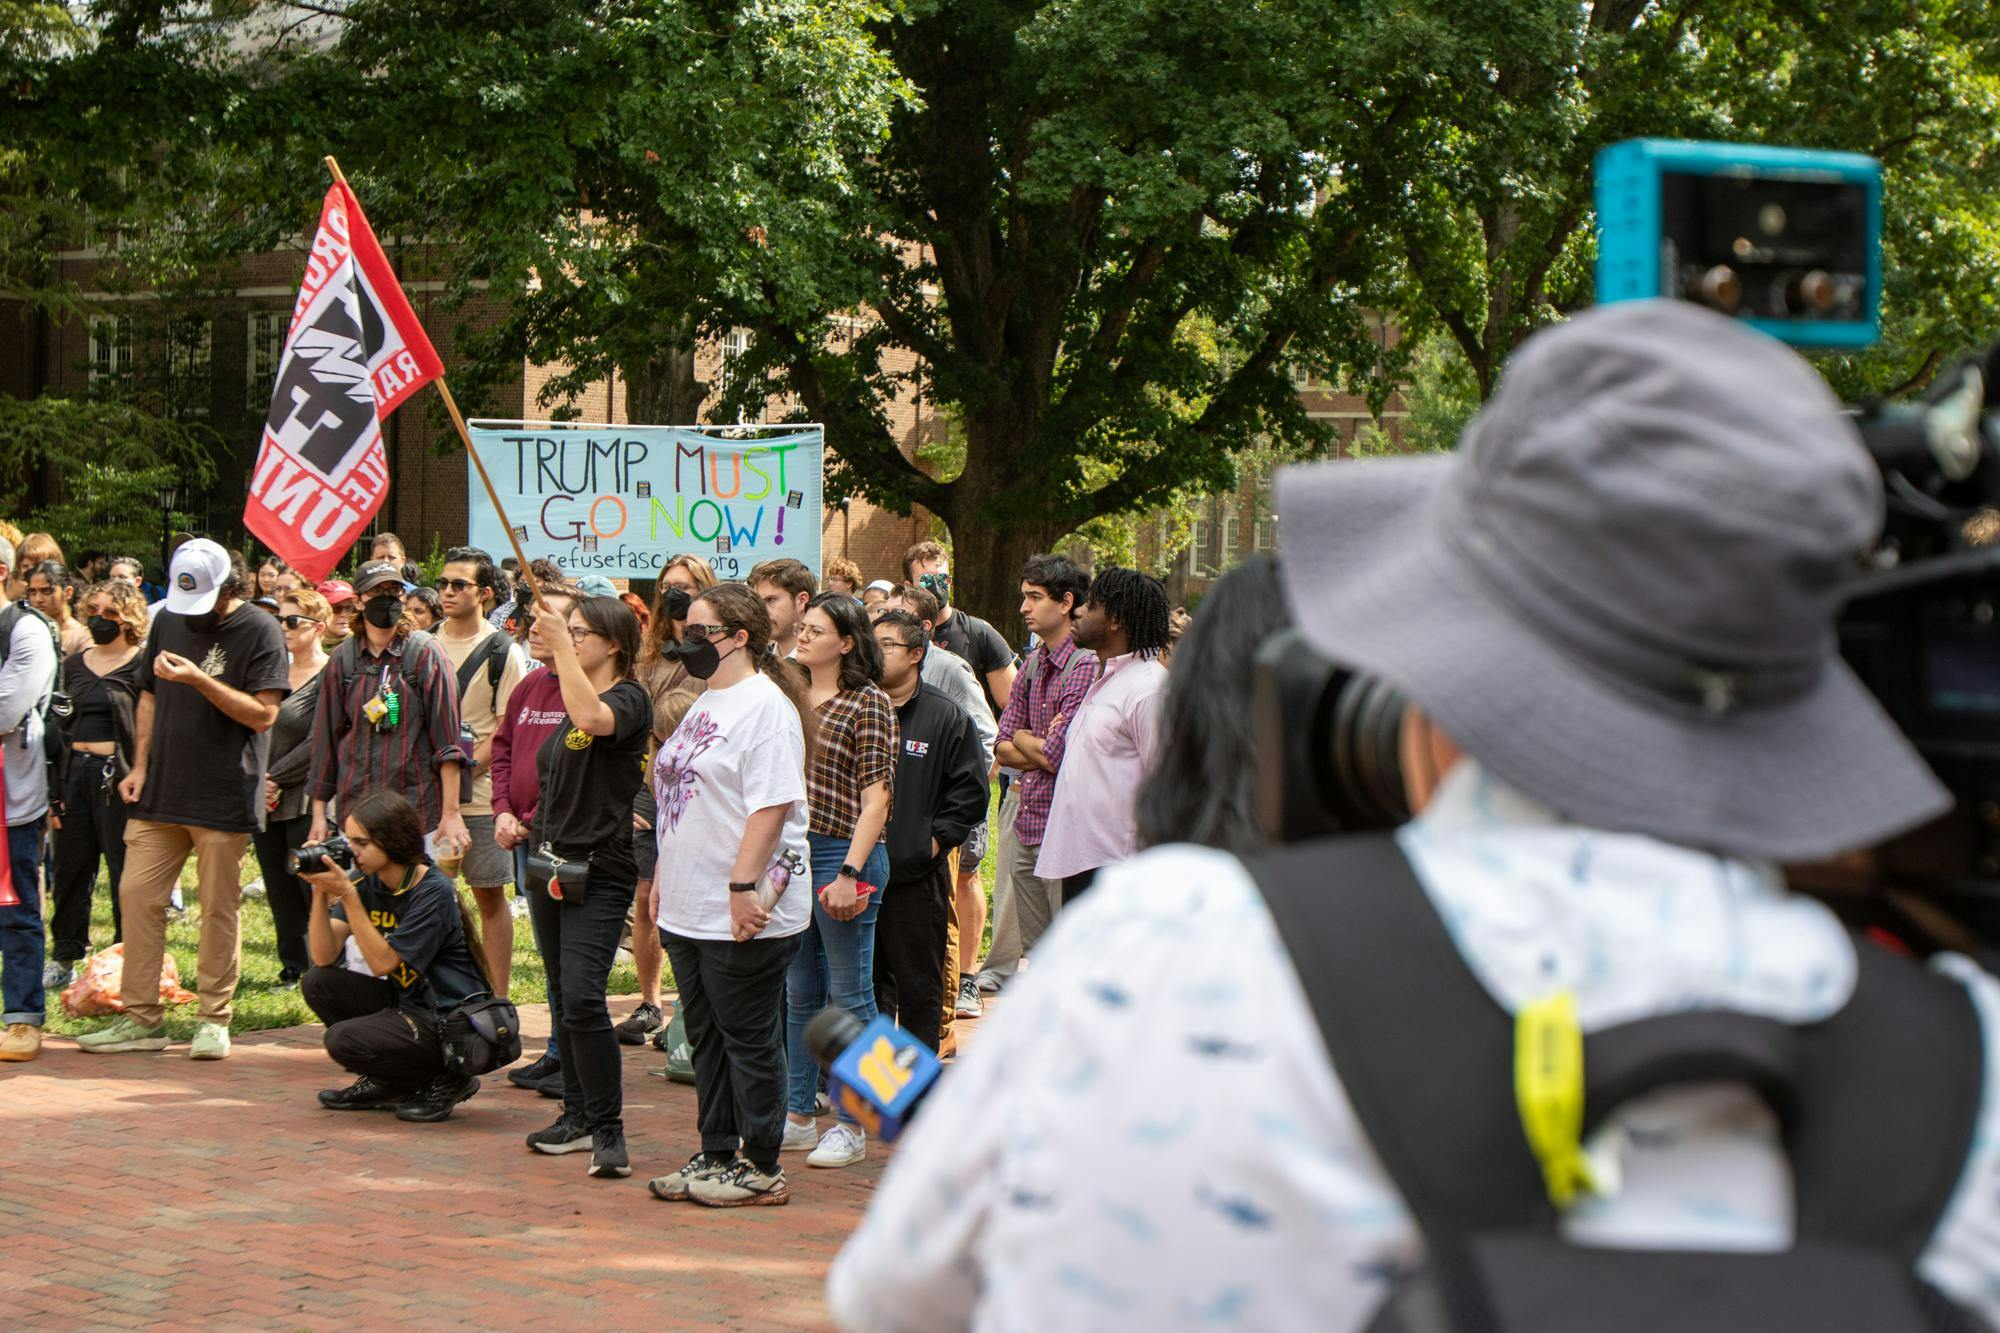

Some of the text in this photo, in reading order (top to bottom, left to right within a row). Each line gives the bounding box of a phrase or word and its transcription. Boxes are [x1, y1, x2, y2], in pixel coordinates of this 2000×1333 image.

[502, 437, 798, 501] TRUMP MUST
[540, 494, 785, 547] GO NOW!
